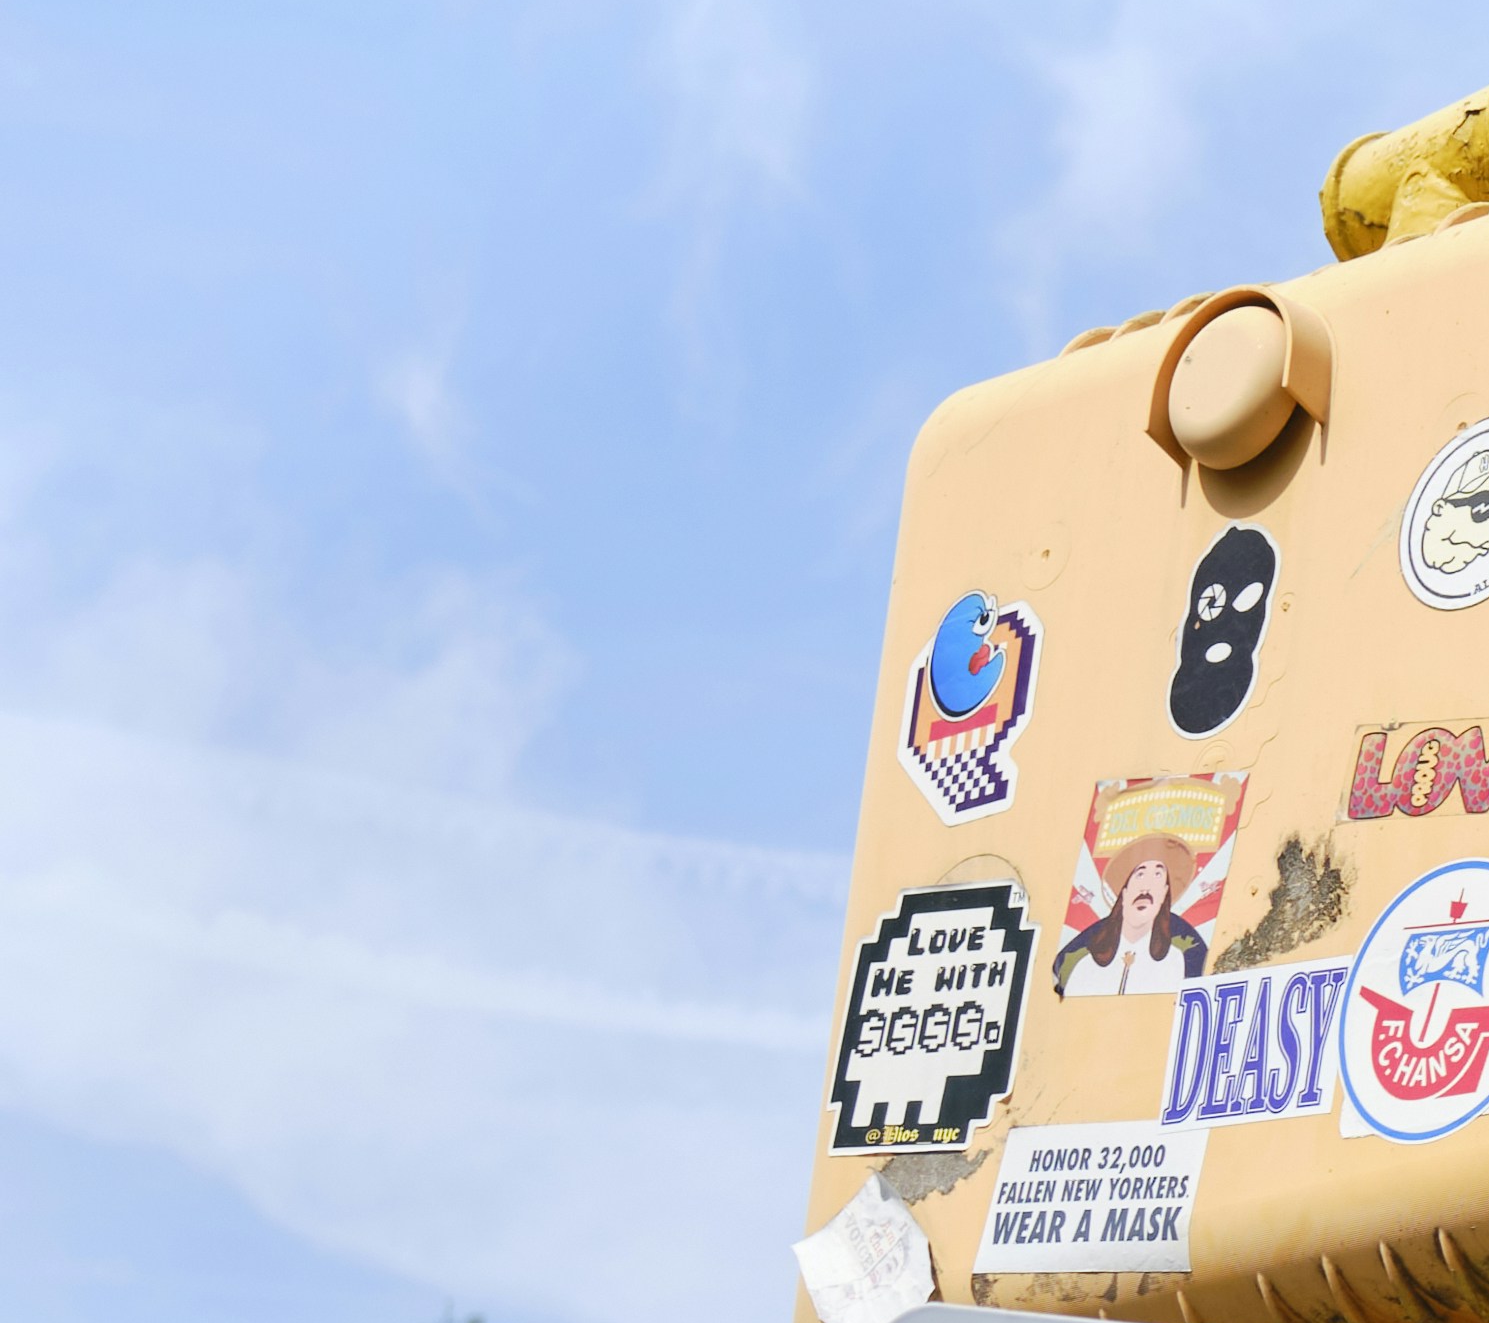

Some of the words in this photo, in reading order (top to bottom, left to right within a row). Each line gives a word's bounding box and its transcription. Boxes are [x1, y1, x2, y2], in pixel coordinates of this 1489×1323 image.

[1144, 803, 1215, 830] COSMOS
[907, 926, 986, 957] LOVE
[870, 967, 914, 998] ME
[934, 961, 1007, 993] WITH
[1162, 967, 1349, 1126] DEASY
[1392, 1022, 1479, 1088] HANSA
[1029, 1148, 1091, 1173] HONOR
[1097, 1144, 1166, 1174] 32,000
[997, 1180, 1055, 1204] FALLEN
[1061, 1178, 1102, 1203] NEW
[992, 1210, 1066, 1245] WEAR
[1072, 1209, 1091, 1243] A
[1099, 1206, 1183, 1243] MASK
